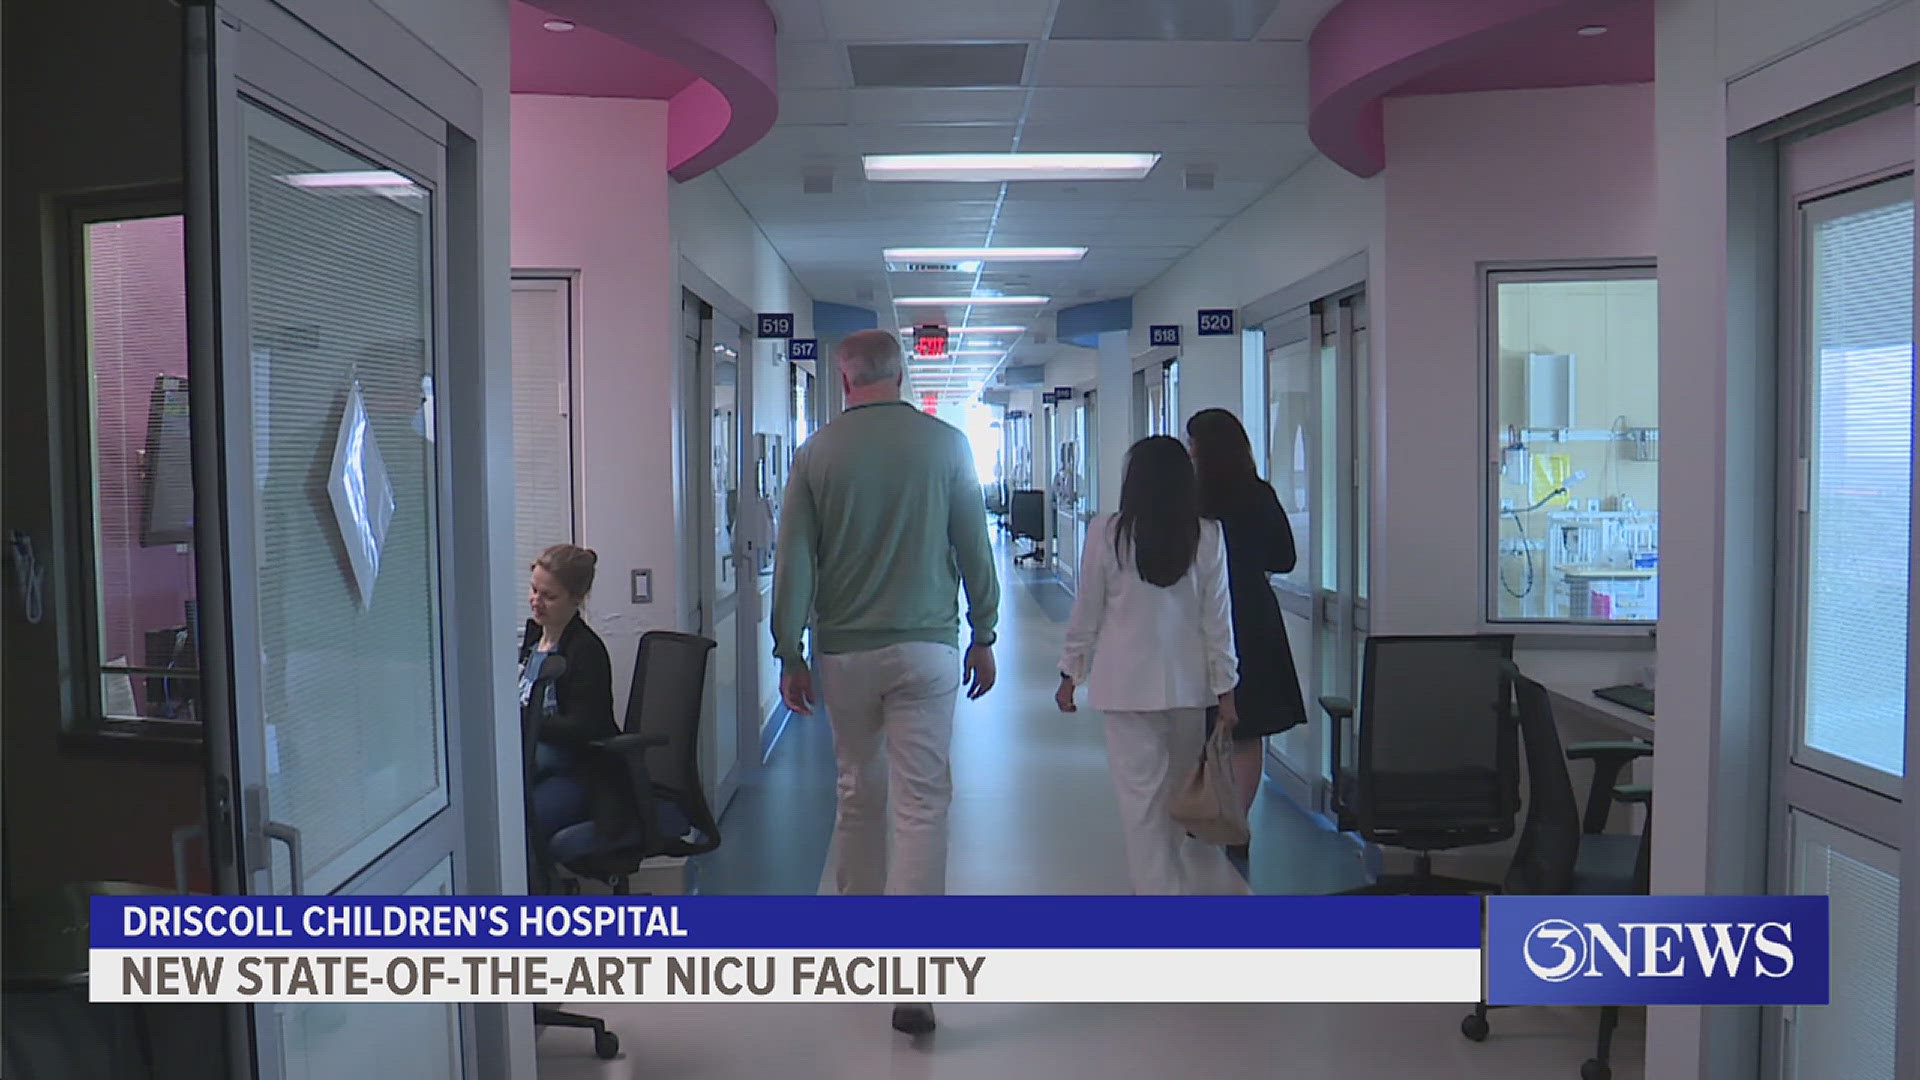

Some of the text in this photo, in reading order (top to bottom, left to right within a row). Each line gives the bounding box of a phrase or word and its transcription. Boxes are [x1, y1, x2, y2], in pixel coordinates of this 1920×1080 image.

[762, 318, 789, 334] 519
[1200, 315, 1231, 330] 520
[1153, 329, 1176, 342] 518
[792, 342, 814, 356] 517
[919, 337, 945, 356] EXIT
